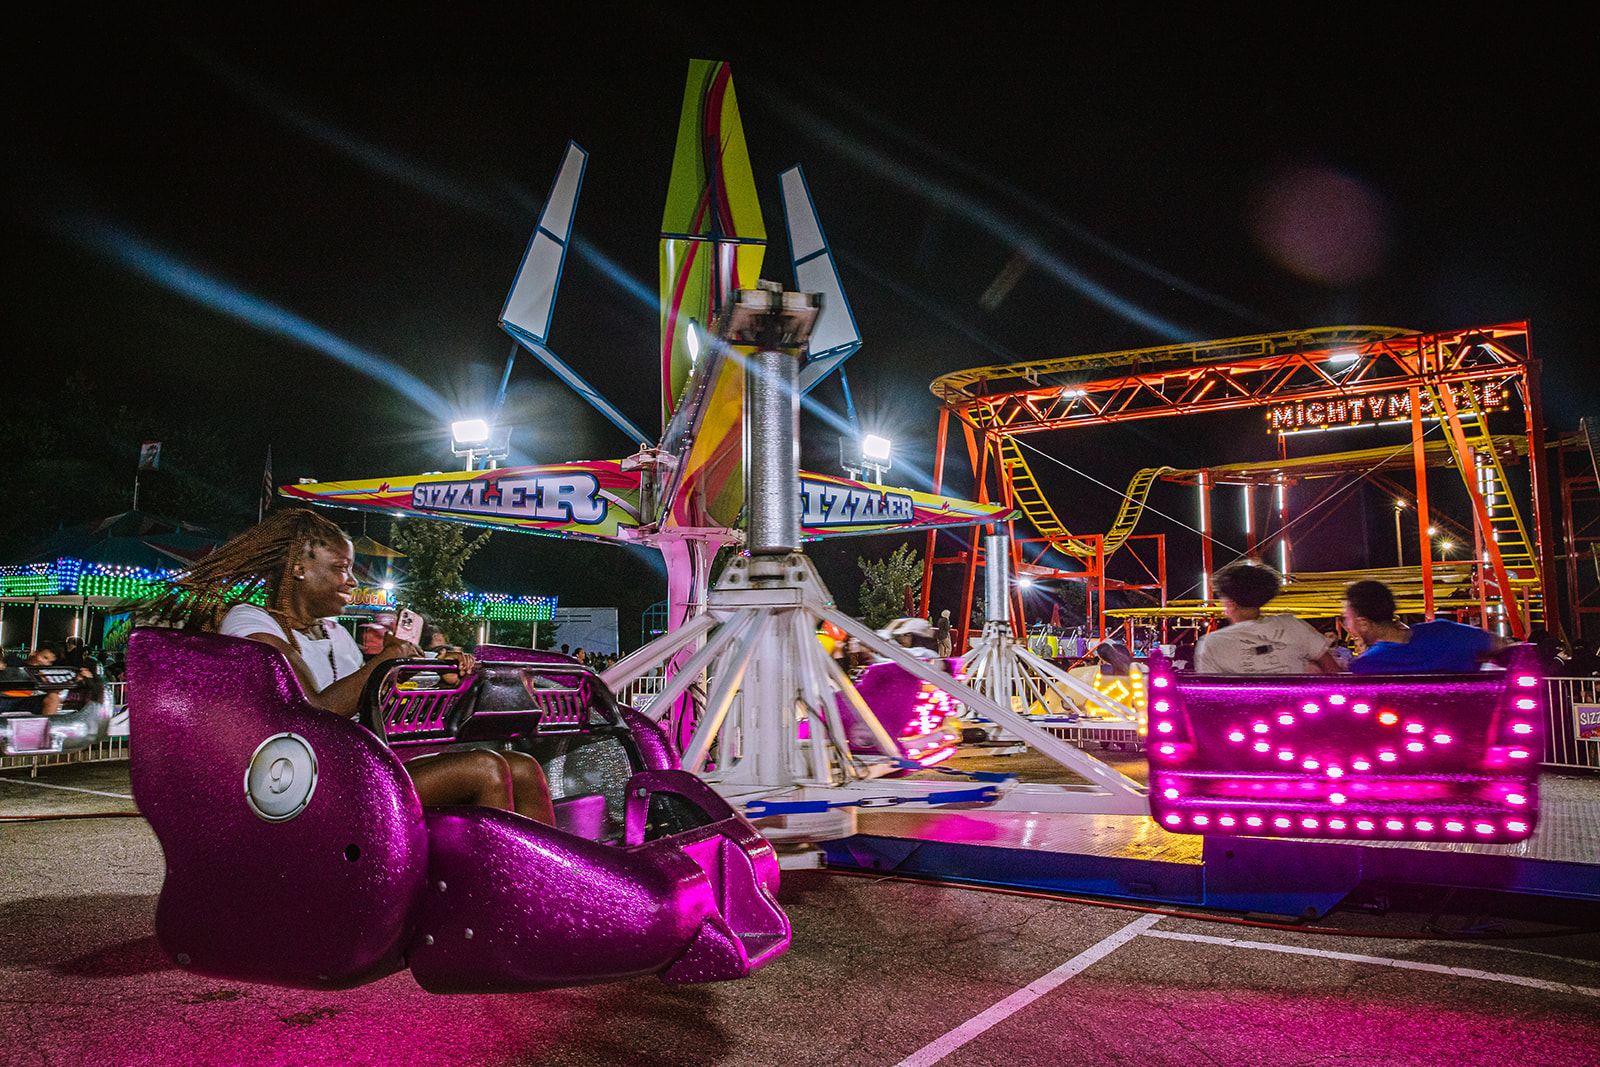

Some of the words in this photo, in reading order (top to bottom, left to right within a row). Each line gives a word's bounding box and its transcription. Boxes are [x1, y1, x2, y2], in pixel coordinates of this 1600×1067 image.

[412, 474, 607, 523] SIZZLER
[800, 481, 914, 526] IZZLER
[269, 757, 295, 795] 9
